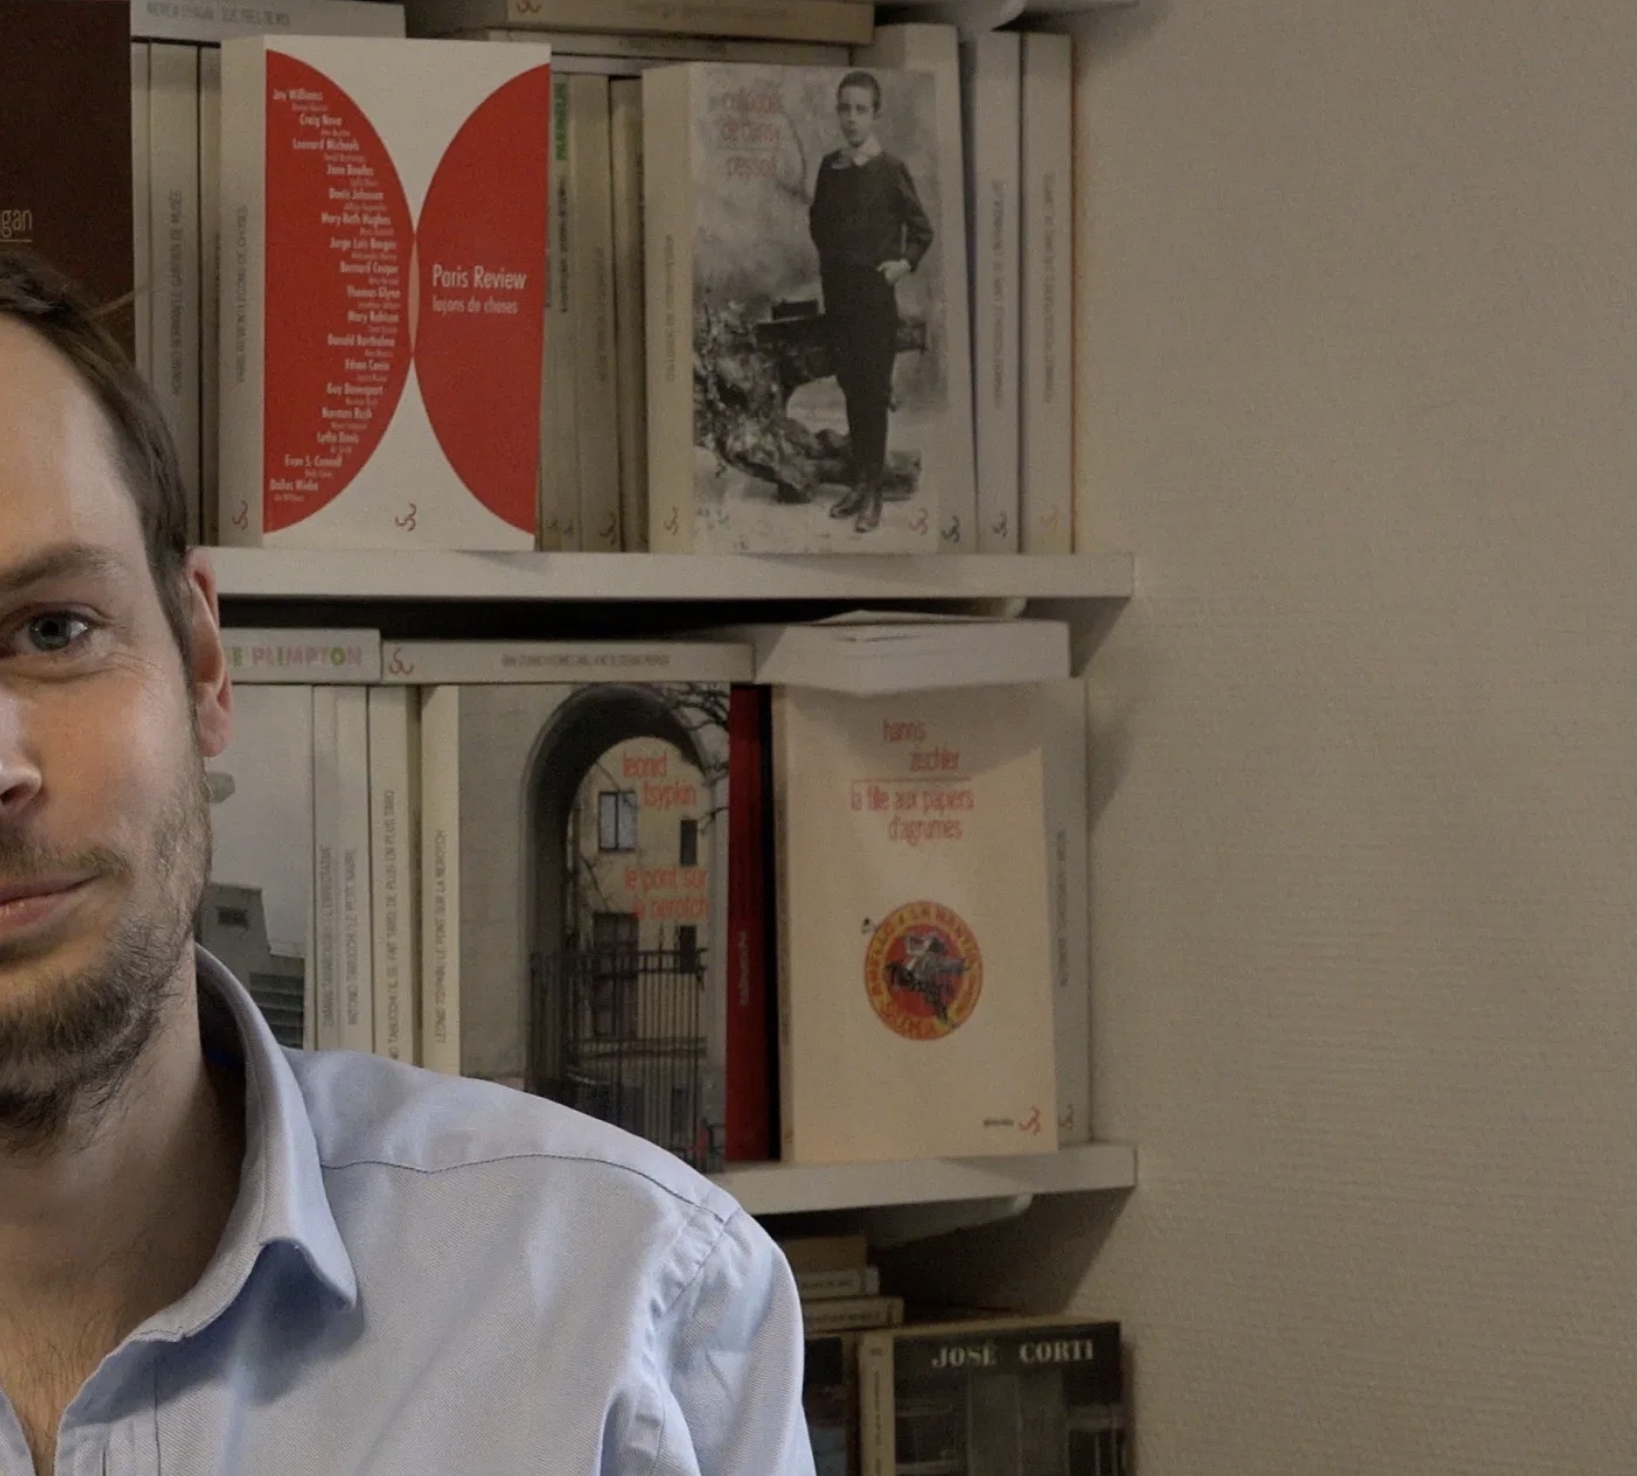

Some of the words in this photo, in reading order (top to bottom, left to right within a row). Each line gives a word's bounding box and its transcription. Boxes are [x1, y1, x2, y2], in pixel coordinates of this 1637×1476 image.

[432, 263, 469, 288] Paris
[473, 264, 527, 289] Review
[327, 333, 355, 346] Donald
[284, 454, 304, 468] Evan
[251, 645, 363, 667] PLIMPTON
[894, 790, 918, 811] aux
[624, 865, 637, 889] le
[644, 864, 677, 892] pont
[684, 869, 708, 889] sur
[931, 1339, 998, 1369] JOSÉ
[1018, 1338, 1094, 1364] CORTI
